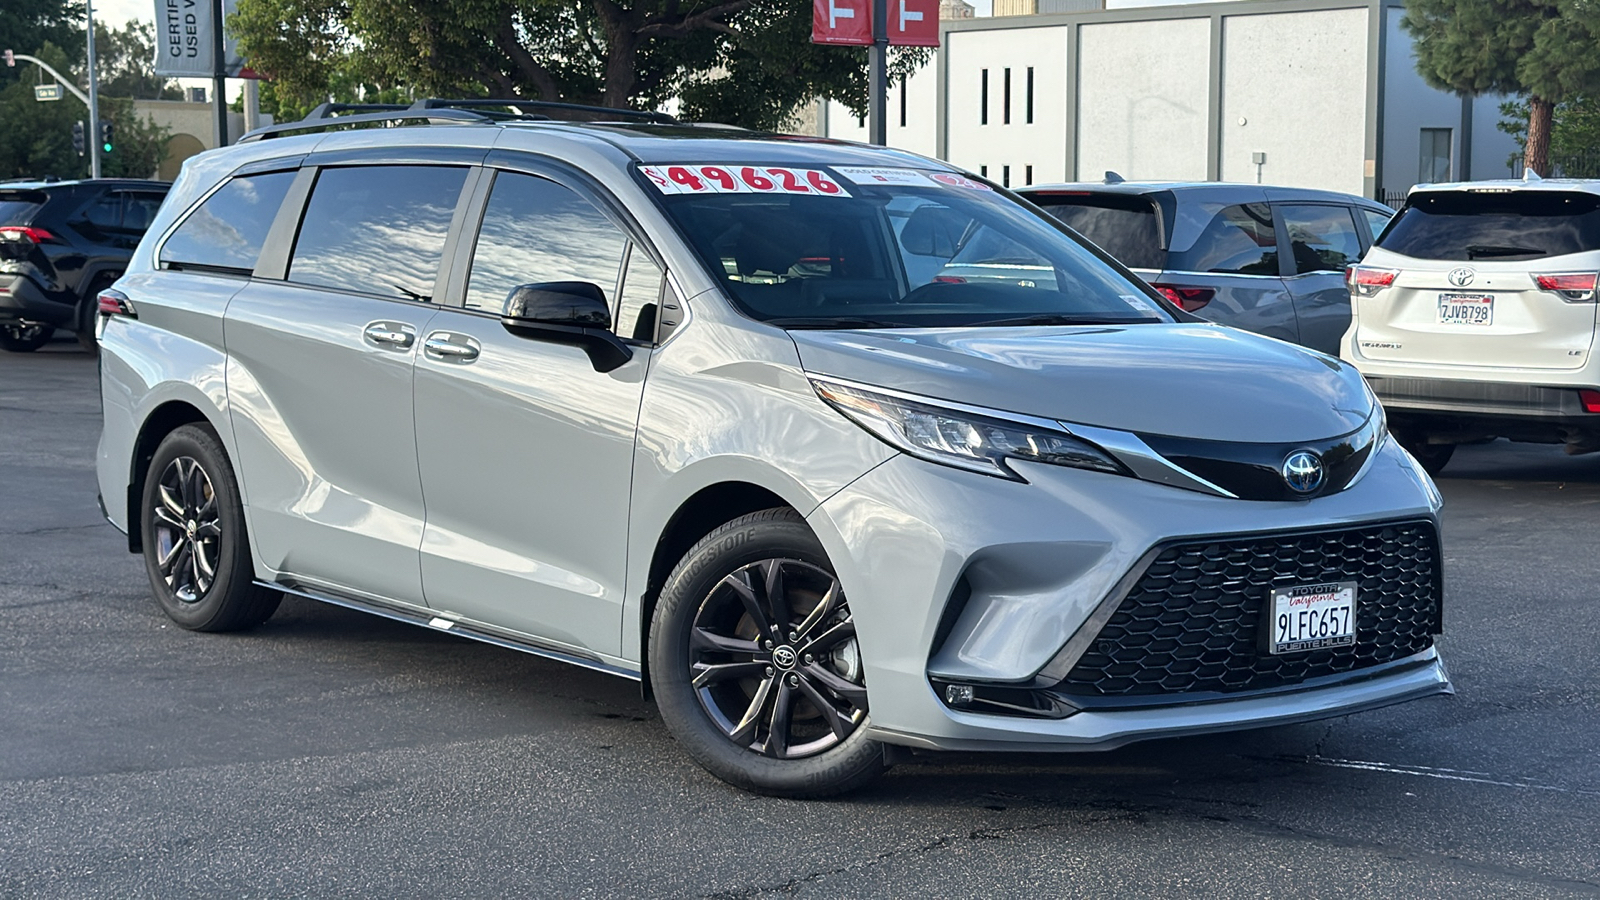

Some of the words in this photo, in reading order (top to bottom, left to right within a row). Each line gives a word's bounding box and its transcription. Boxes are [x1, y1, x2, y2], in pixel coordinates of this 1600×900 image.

[185, 13, 198, 58] USED
[1441, 304, 1489, 320] 7JVB798
[665, 527, 756, 617] BRIDGESTONE
[1294, 585, 1337, 595] TOYOTA
[1289, 593, 1340, 609] California
[1278, 606, 1350, 642] 9LFC657
[1278, 641, 1320, 652] PUENTE
[1321, 637, 1351, 647] HILLS
